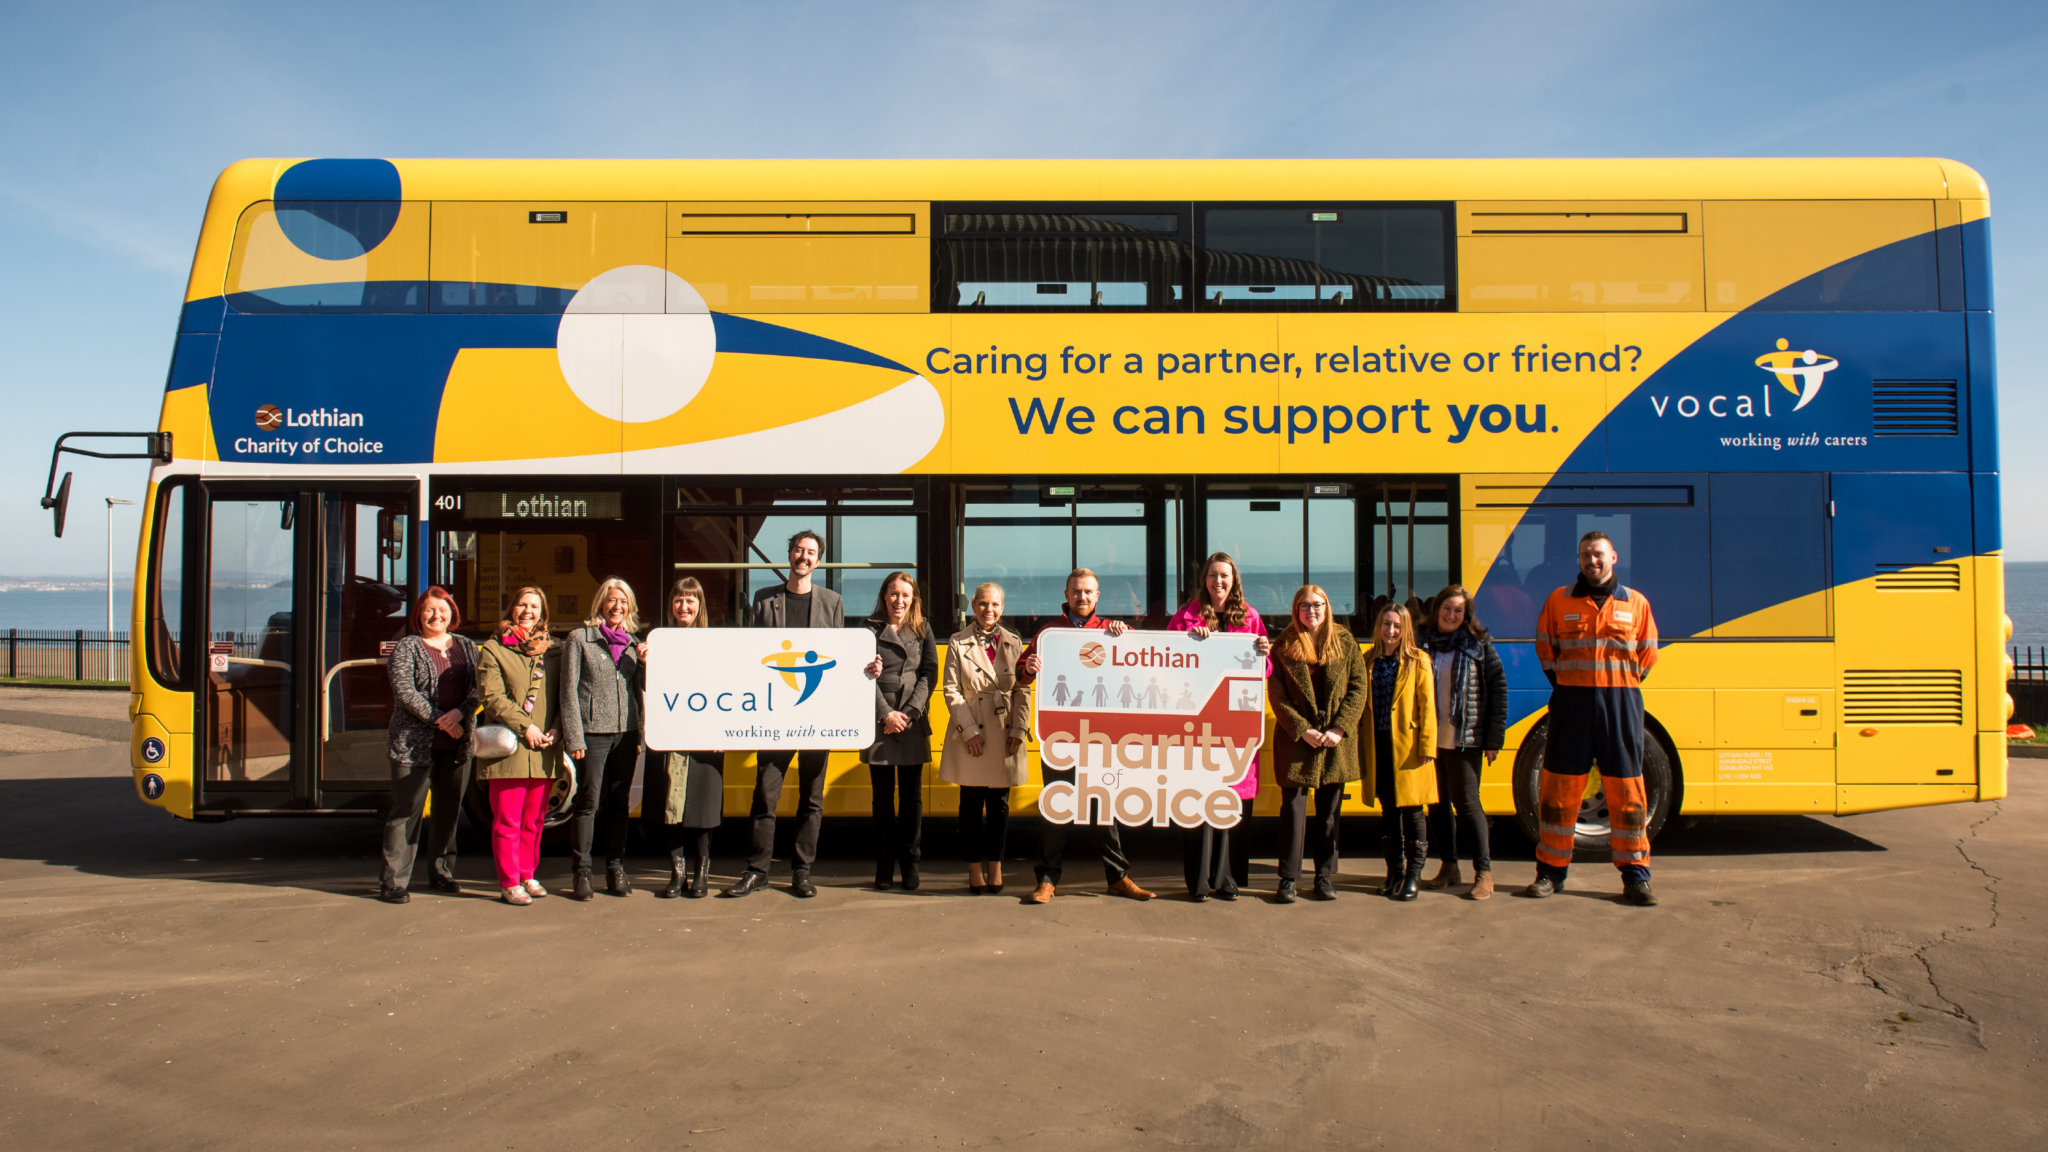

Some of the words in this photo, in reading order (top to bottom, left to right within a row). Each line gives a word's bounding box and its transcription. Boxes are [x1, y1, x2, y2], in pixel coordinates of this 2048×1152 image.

[926, 345, 1047, 381] Caring
[1060, 345, 1112, 374] for
[1124, 353, 1143, 374] a
[1158, 349, 1302, 381] partner,
[1315, 344, 1451, 373] relative
[1463, 352, 1500, 373] or
[1511, 344, 1643, 373] friend?
[1650, 383, 1772, 418] vocal
[286, 407, 364, 427] Lothian
[1009, 397, 1095, 435] We
[1113, 405, 1205, 435] can
[1225, 399, 1431, 444] support
[1447, 404, 1559, 444] you.
[234, 437, 299, 457] Charity
[301, 437, 321, 454] of
[324, 437, 384, 454] Choice
[1719, 433, 1782, 451] working
[1787, 431, 1820, 447] with
[1824, 436, 1868, 447] carers
[434, 495, 461, 510] 401
[501, 493, 588, 517] Lothian
[507, 565, 520, 573] for
[1111, 645, 1200, 669] Lothian
[662, 682, 774, 713] vocal
[724, 724, 781, 743] working
[786, 724, 816, 739] with
[820, 728, 860, 739] carers
[1043, 718, 1259, 784] charity
[1101, 768, 1124, 790] of
[1042, 772, 1240, 826] choice
